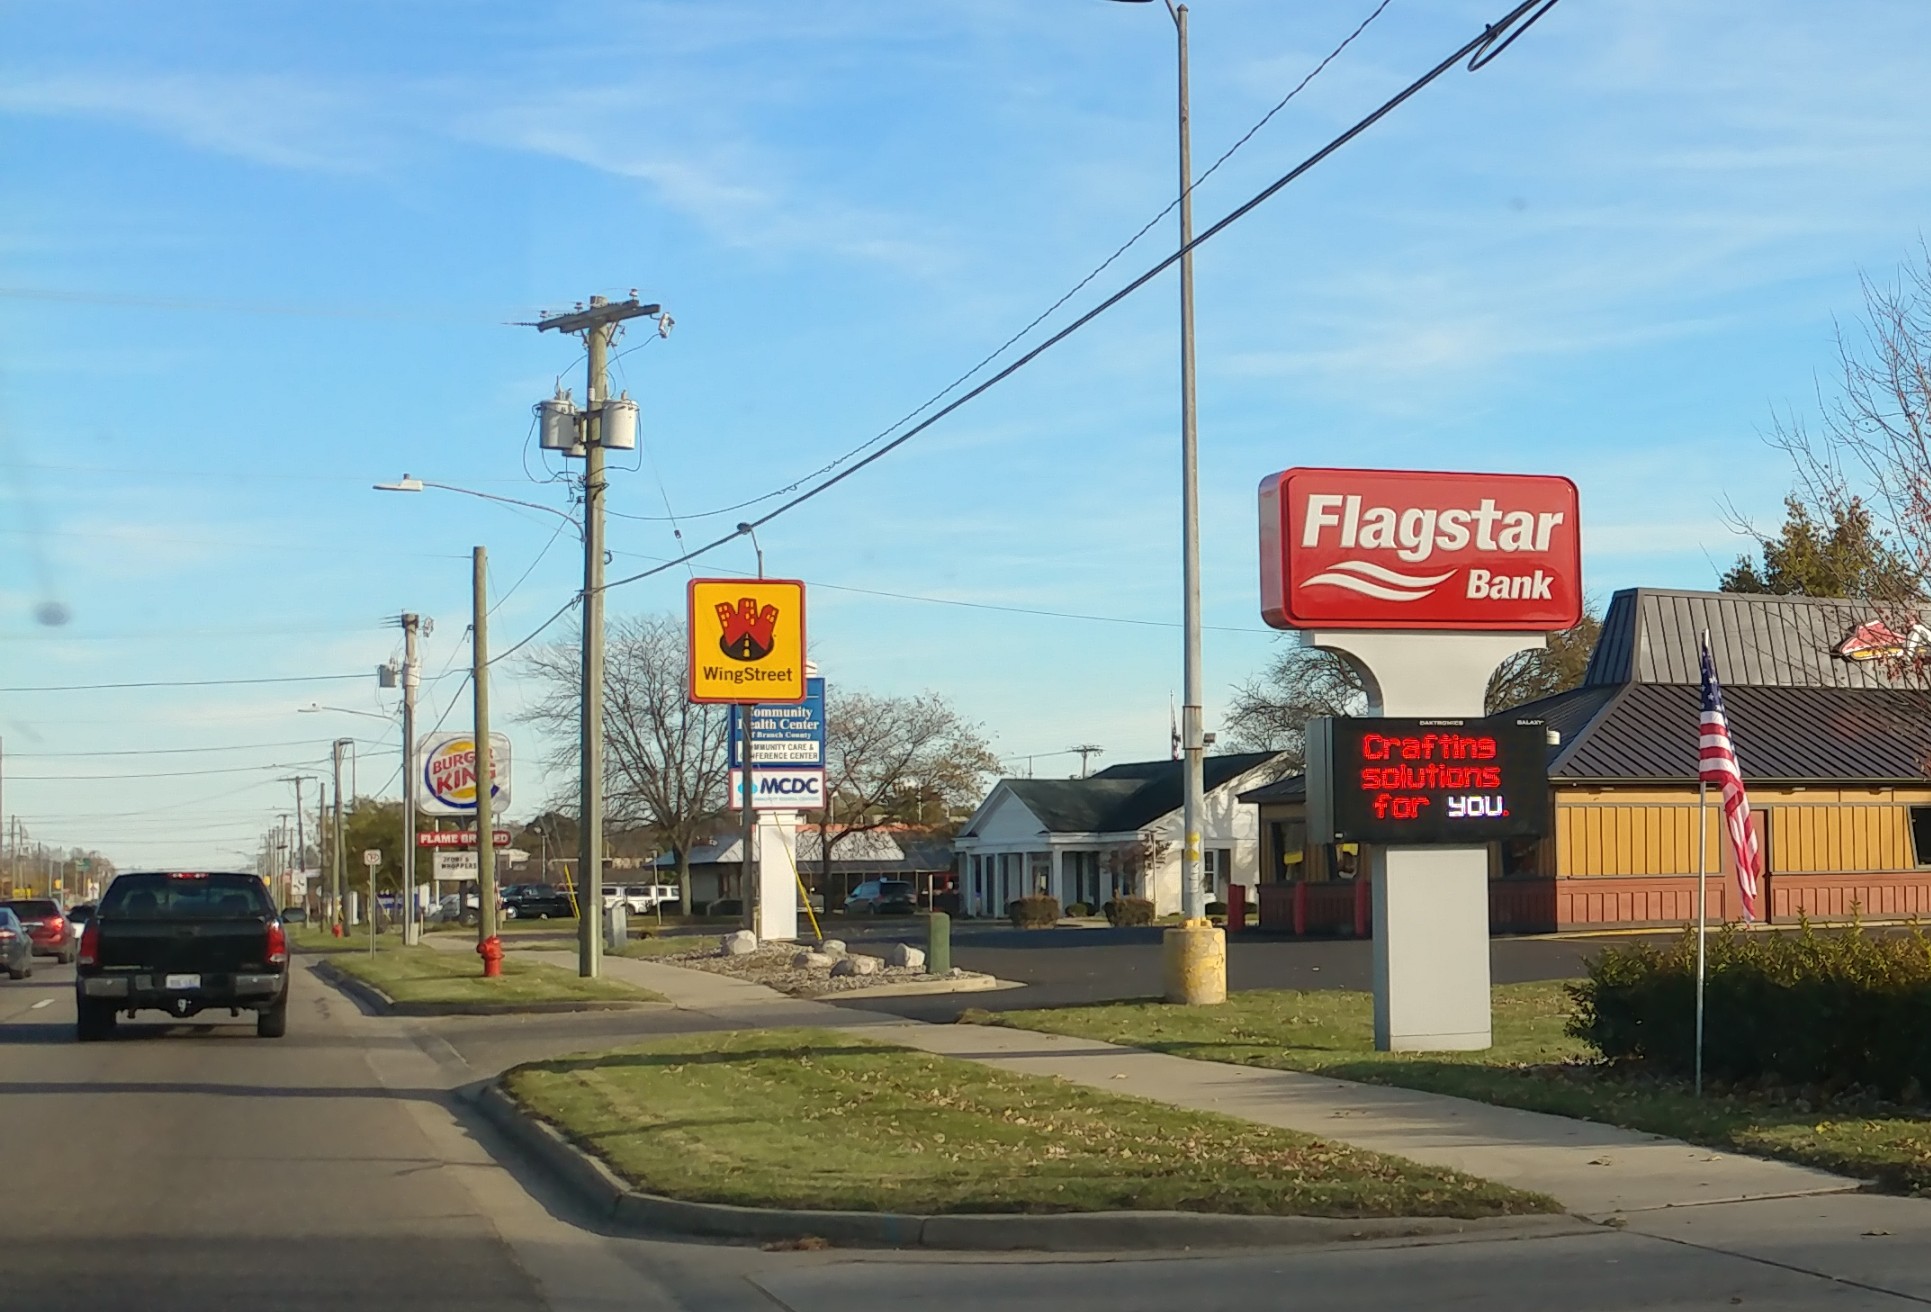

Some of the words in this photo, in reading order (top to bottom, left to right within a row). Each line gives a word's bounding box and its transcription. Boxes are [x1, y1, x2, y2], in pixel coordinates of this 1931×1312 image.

[1300, 494, 1563, 562] Flagstar
[1466, 569, 1554, 601] Bank
[703, 666, 793, 684] WingStreet
[751, 706, 813, 720] ommunity
[780, 718, 820, 730] Center
[785, 731, 811, 739] County
[751, 743, 786, 751] MMUNITY
[787, 743, 807, 751] CARE
[809, 743, 814, 751] &
[433, 748, 494, 775] BURG
[789, 752, 818, 760] CENTER
[436, 767, 496, 795] KIN
[1361, 763, 1502, 790] solutions
[760, 777, 819, 794] MCDC
[1374, 793, 1430, 819] for
[420, 833, 459, 844] FLAME
[460, 833, 509, 844] GRED
